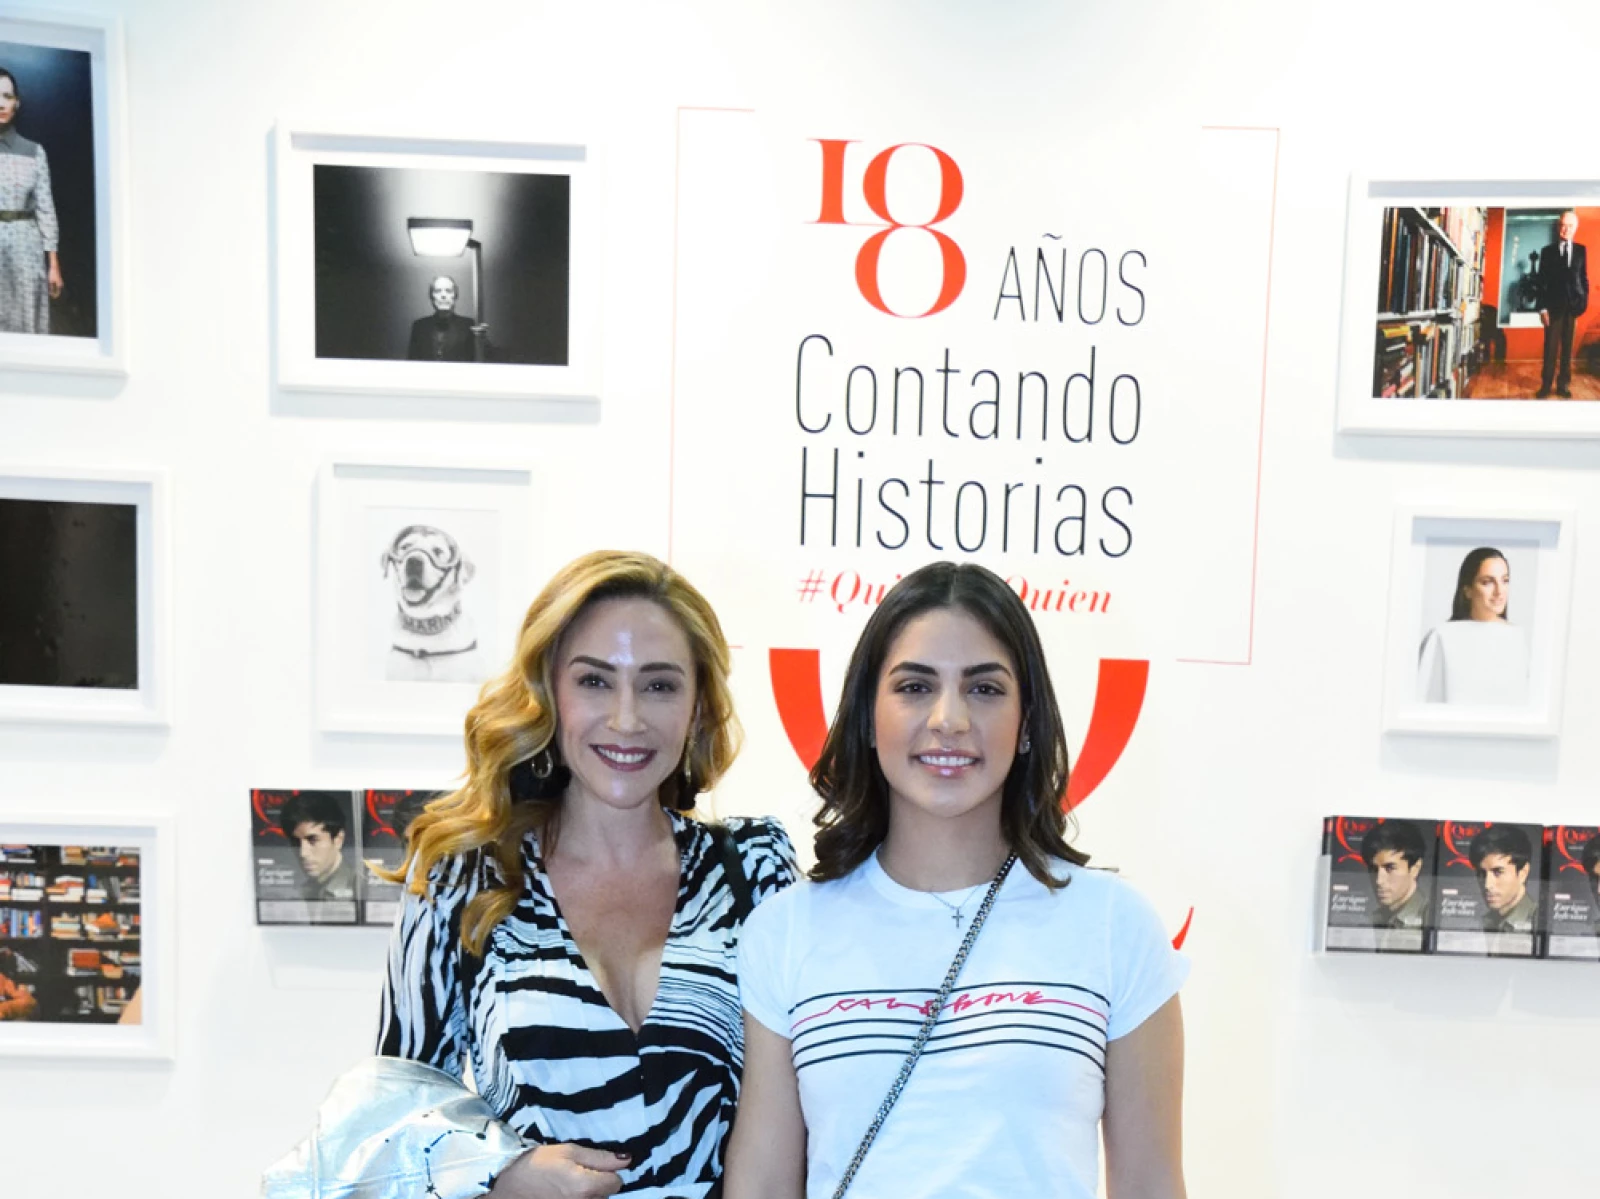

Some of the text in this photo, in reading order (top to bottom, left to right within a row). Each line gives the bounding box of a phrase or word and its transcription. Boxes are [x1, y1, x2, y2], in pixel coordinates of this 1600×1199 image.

[803, 138, 1147, 326] 18 AÑOS
[796, 334, 1141, 445] Contando
[799, 446, 1133, 558] Historias
